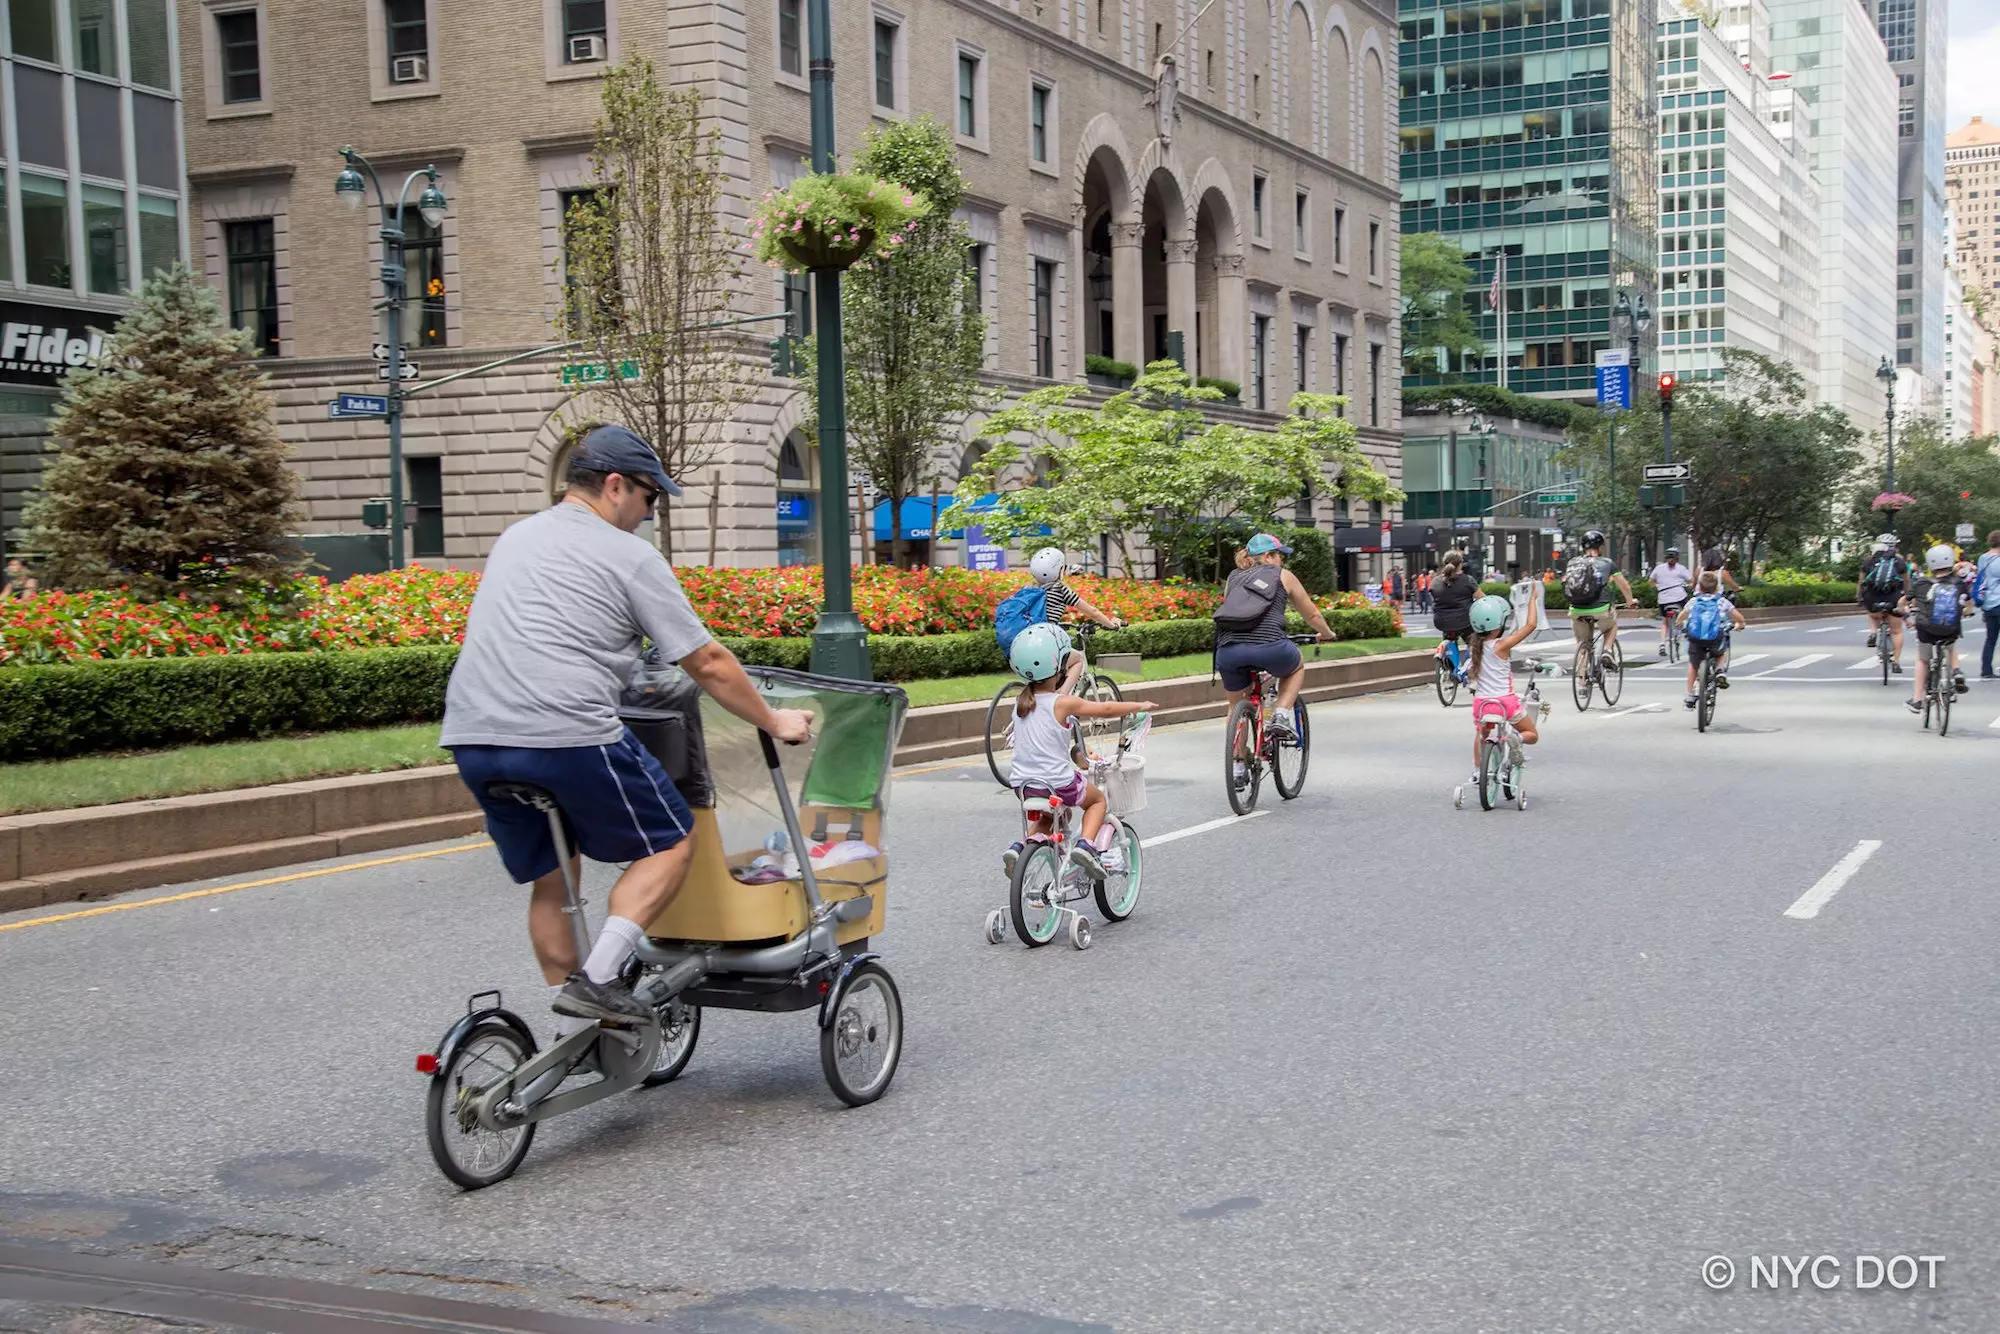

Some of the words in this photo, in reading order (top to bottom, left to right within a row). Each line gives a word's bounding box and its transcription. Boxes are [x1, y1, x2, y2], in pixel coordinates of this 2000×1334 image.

[347, 398, 364, 409] Park
[366, 400, 380, 411] Ave
[776, 501, 792, 514] SE
[911, 529, 942, 537] CHAE
[975, 561, 998, 570] STOP
